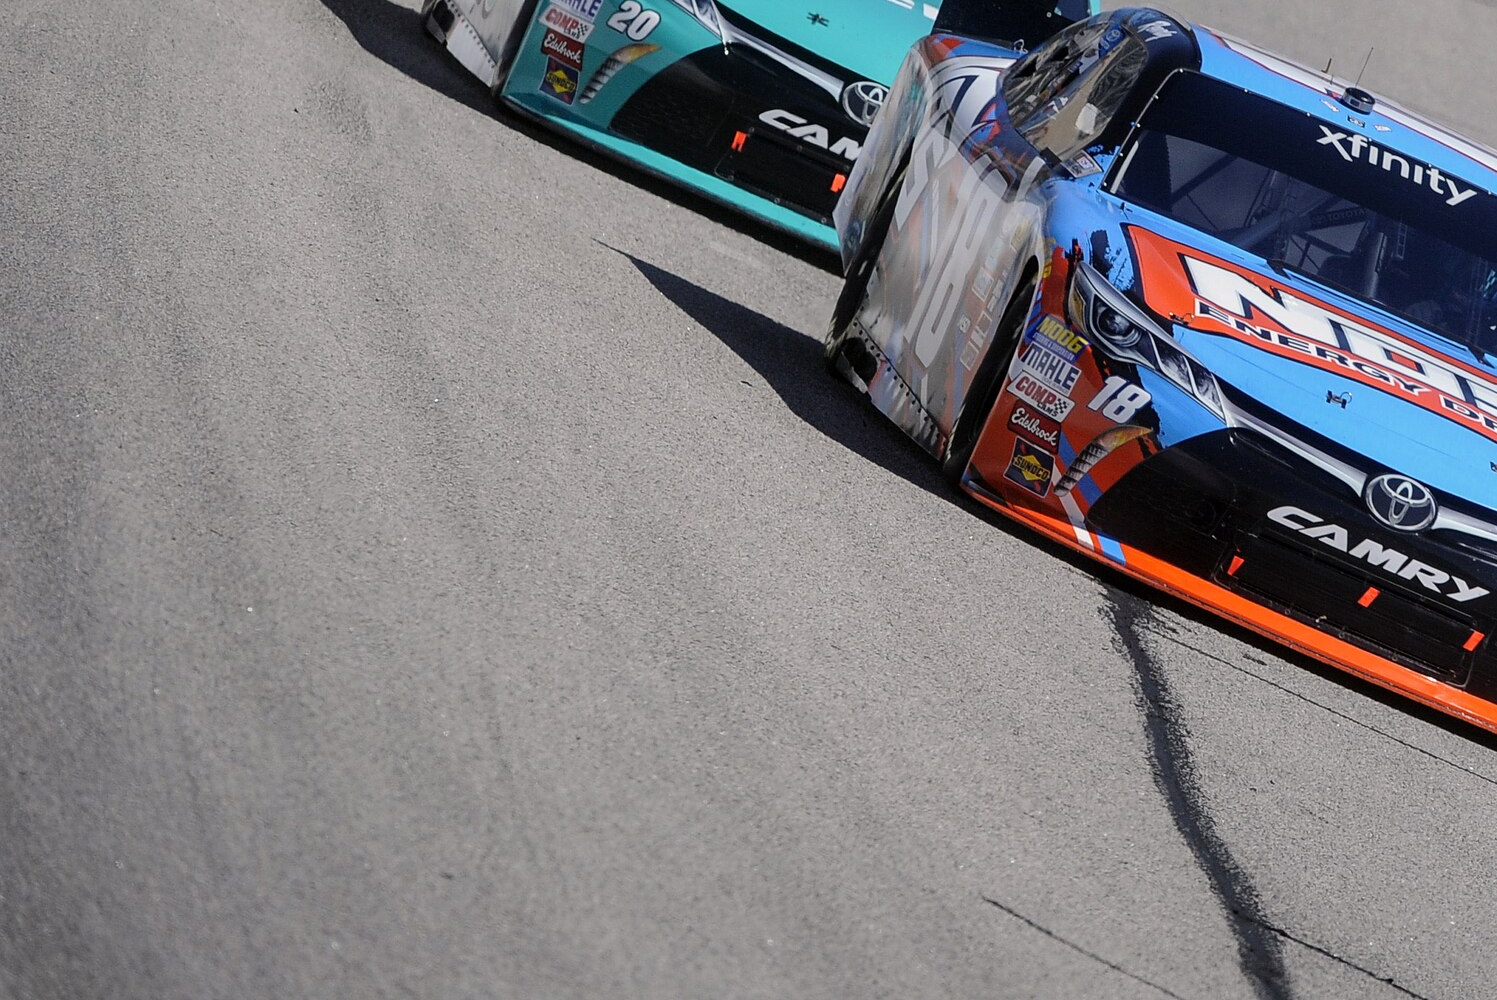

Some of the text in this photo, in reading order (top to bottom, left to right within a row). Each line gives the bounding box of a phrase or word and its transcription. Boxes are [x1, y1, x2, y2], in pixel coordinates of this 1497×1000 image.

[545, 8, 579, 30] COMP
[544, 33, 582, 63] Edelbrock
[758, 109, 863, 161] CAM
[1316, 124, 1477, 206] xfinity
[1036, 317, 1088, 354] MOOG
[1194, 298, 1432, 396] ENERGY
[1021, 348, 1080, 389] MAHLE
[1015, 376, 1056, 407] COMP
[1036, 401, 1058, 417] CAMS
[1087, 375, 1152, 424] 18
[1011, 407, 1058, 446] Edelbrock
[1013, 456, 1050, 482] SUNOCO
[1266, 505, 1491, 602] CAMRY
